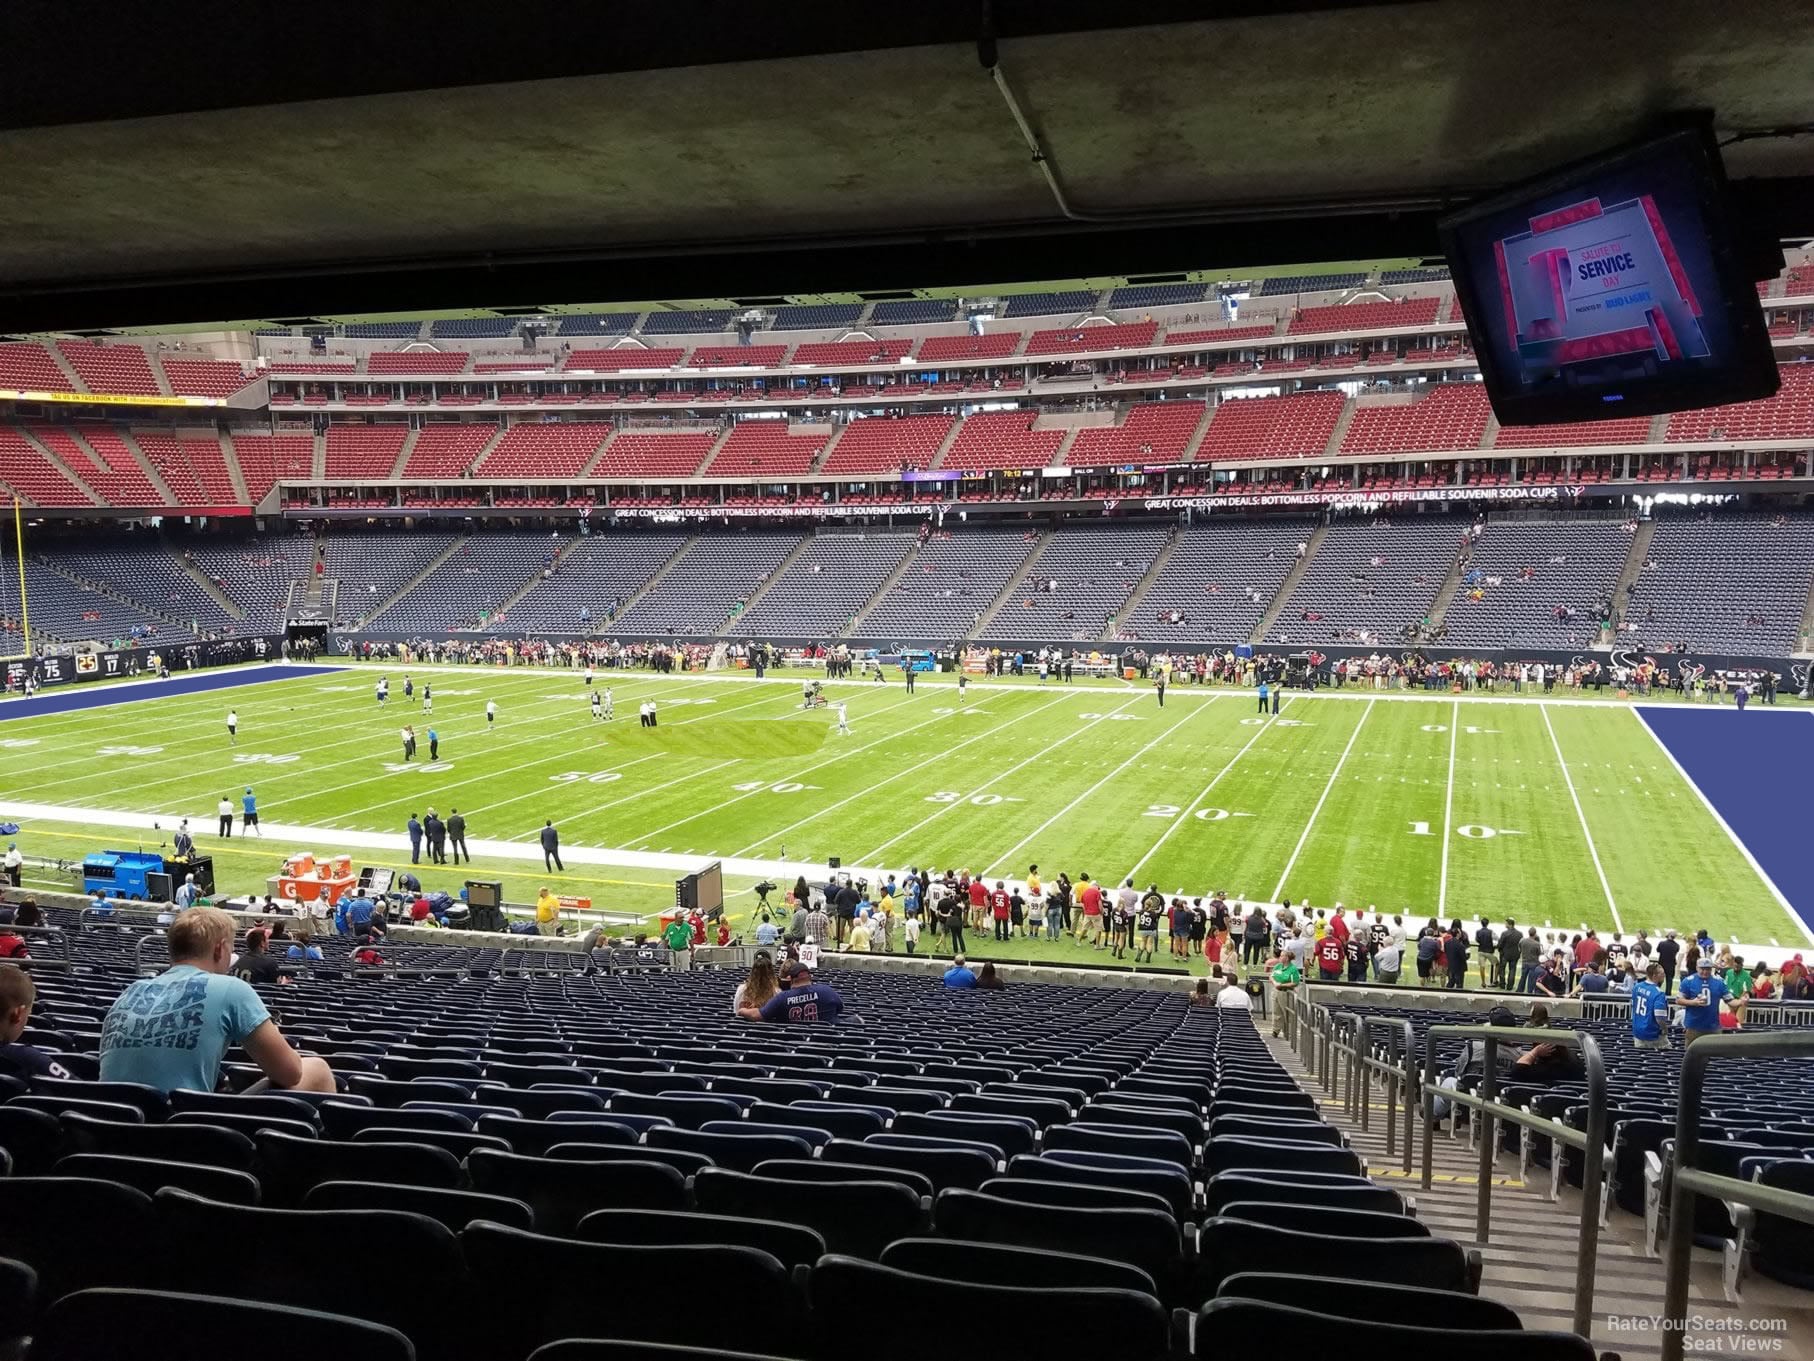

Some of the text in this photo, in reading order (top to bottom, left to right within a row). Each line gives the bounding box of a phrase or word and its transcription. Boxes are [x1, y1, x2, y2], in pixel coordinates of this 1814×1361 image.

[1578, 252, 1635, 280] SERVICE
[1602, 275, 1620, 288] DAY
[1144, 500, 1171, 509] GREAT
[1172, 498, 1226, 508] CONCESSION
[1261, 495, 1320, 505] BOTTOMLESS
[1321, 493, 1367, 503] POPCORN
[1368, 492, 1391, 501] AND
[1392, 490, 1446, 501] REFILLABLE
[1447, 489, 1498, 499] SOUVENIR
[1500, 488, 1528, 499] SODA
[1530, 487, 1558, 498] CUPS
[615, 509, 638, 517] GREAT
[638, 509, 684, 517] CONCESSION
[711, 508, 757, 517] BOTTOMLESS
[758, 508, 794, 517] POPCORN
[794, 508, 810, 516] AND
[811, 507, 852, 516] REFILLABLE
[853, 506, 889, 515] SOUVENIR
[890, 506, 911, 515] SODA
[912, 505, 932, 514] CUPS
[79, 656, 95, 671] 25
[107, 660, 118, 672] 17
[44, 665, 60, 678] 75
[549, 771, 623, 782] 50
[731, 781, 804, 793] 40
[925, 791, 1003, 805] 30
[1142, 805, 1229, 820] 20
[1406, 821, 1497, 839] 10
[284, 882, 297, 898] G
[1140, 914, 1152, 926] 99
[777, 950, 788, 961] 99
[801, 950, 813, 961] 90
[1323, 947, 1339, 960] 56
[1347, 949, 1358, 961] 75
[1635, 995, 1647, 1016] 15
[49, 1062, 70, 1079] 9
